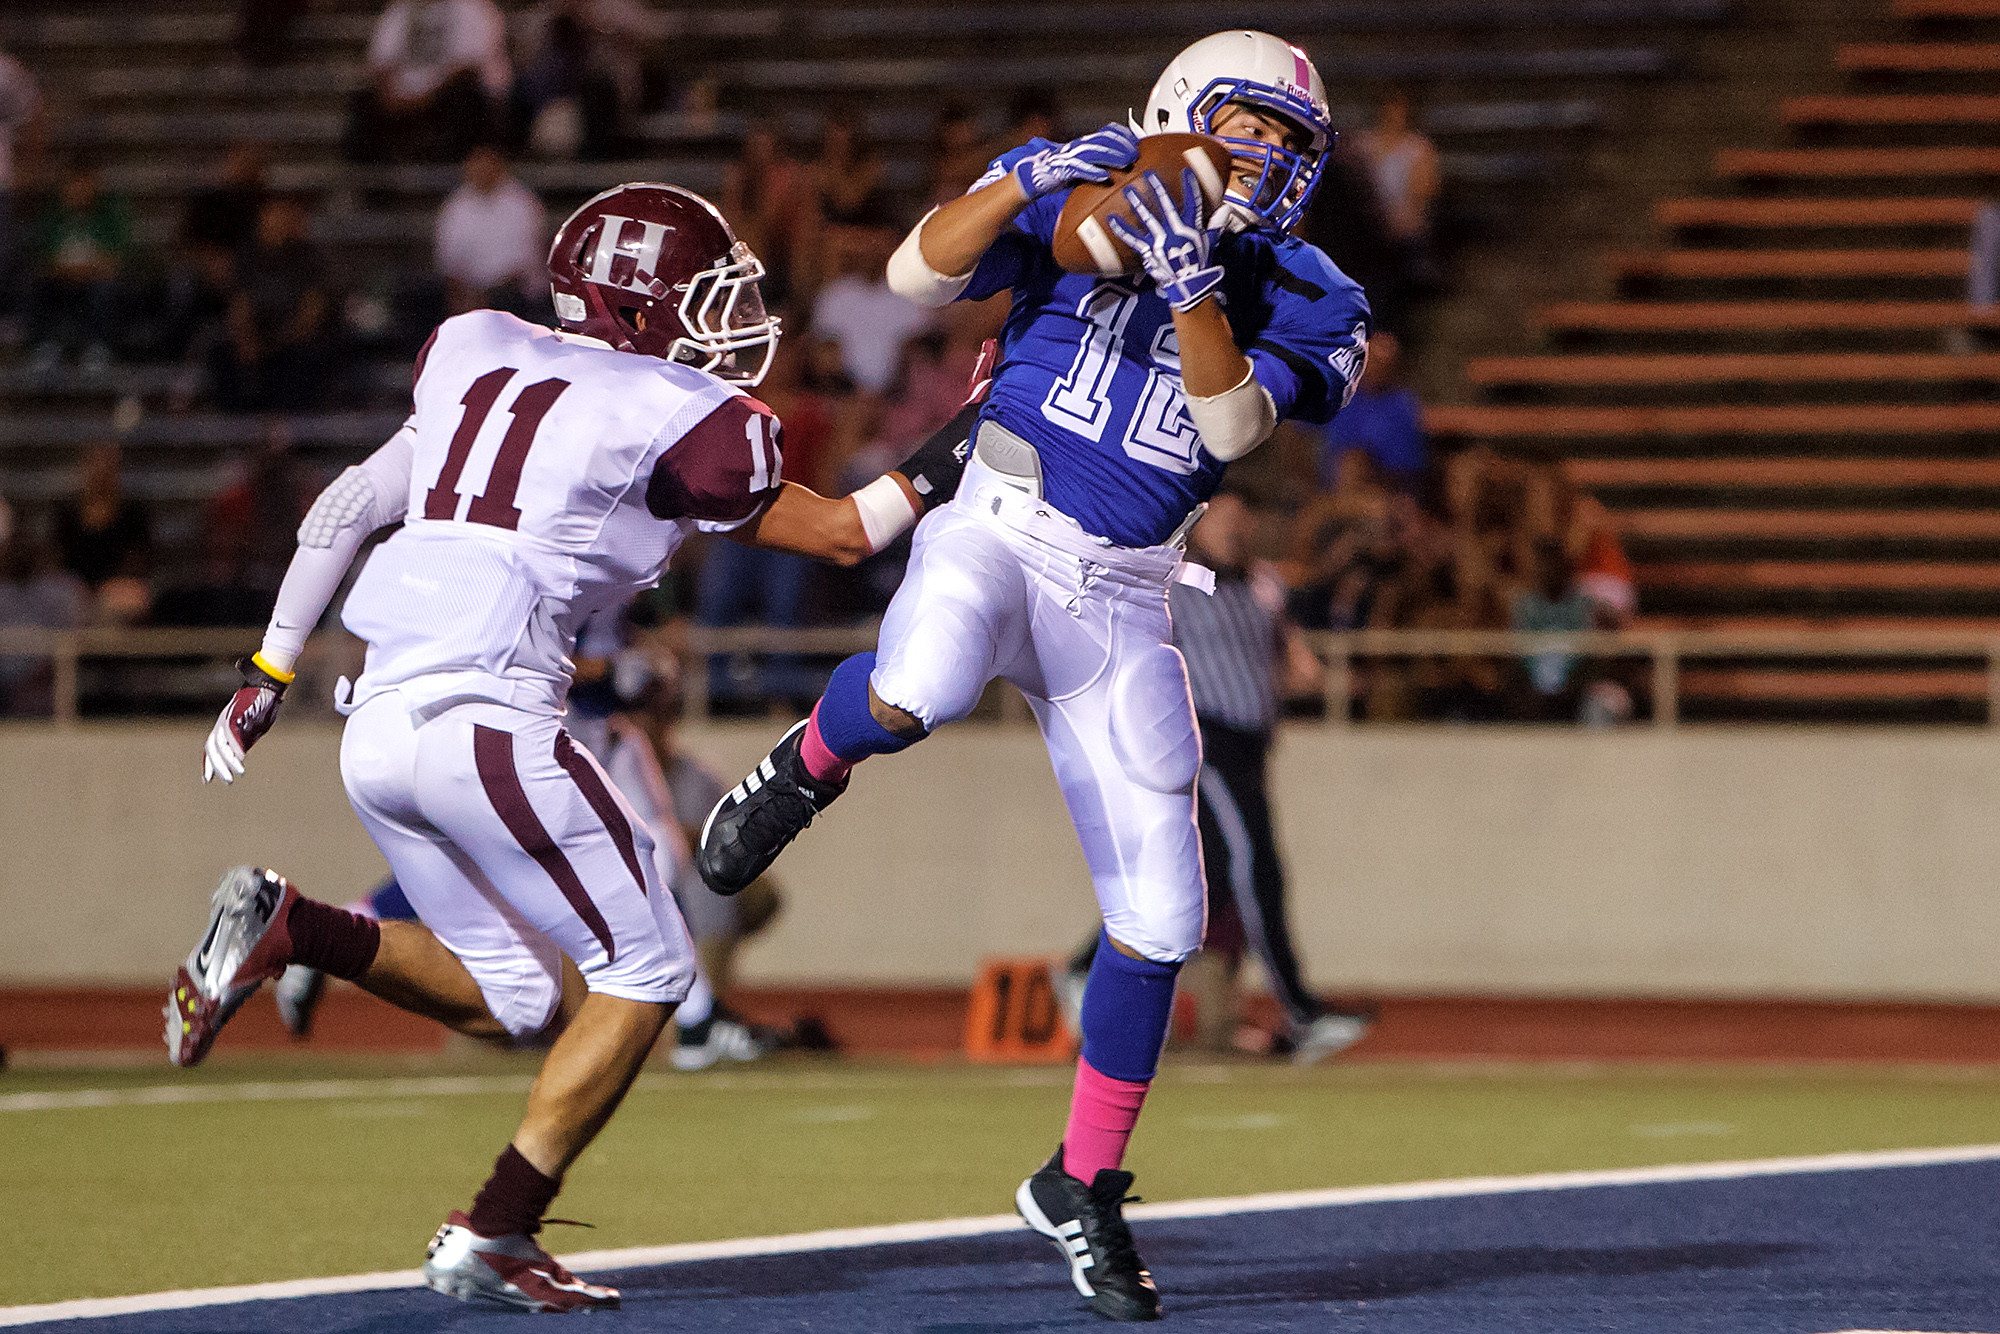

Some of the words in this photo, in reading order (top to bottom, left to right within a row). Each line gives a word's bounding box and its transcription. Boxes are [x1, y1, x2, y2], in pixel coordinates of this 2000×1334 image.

[582, 214, 676, 297] H
[1041, 281, 1202, 475] 12
[421, 366, 572, 532] 11
[993, 967, 1059, 1044] 10
